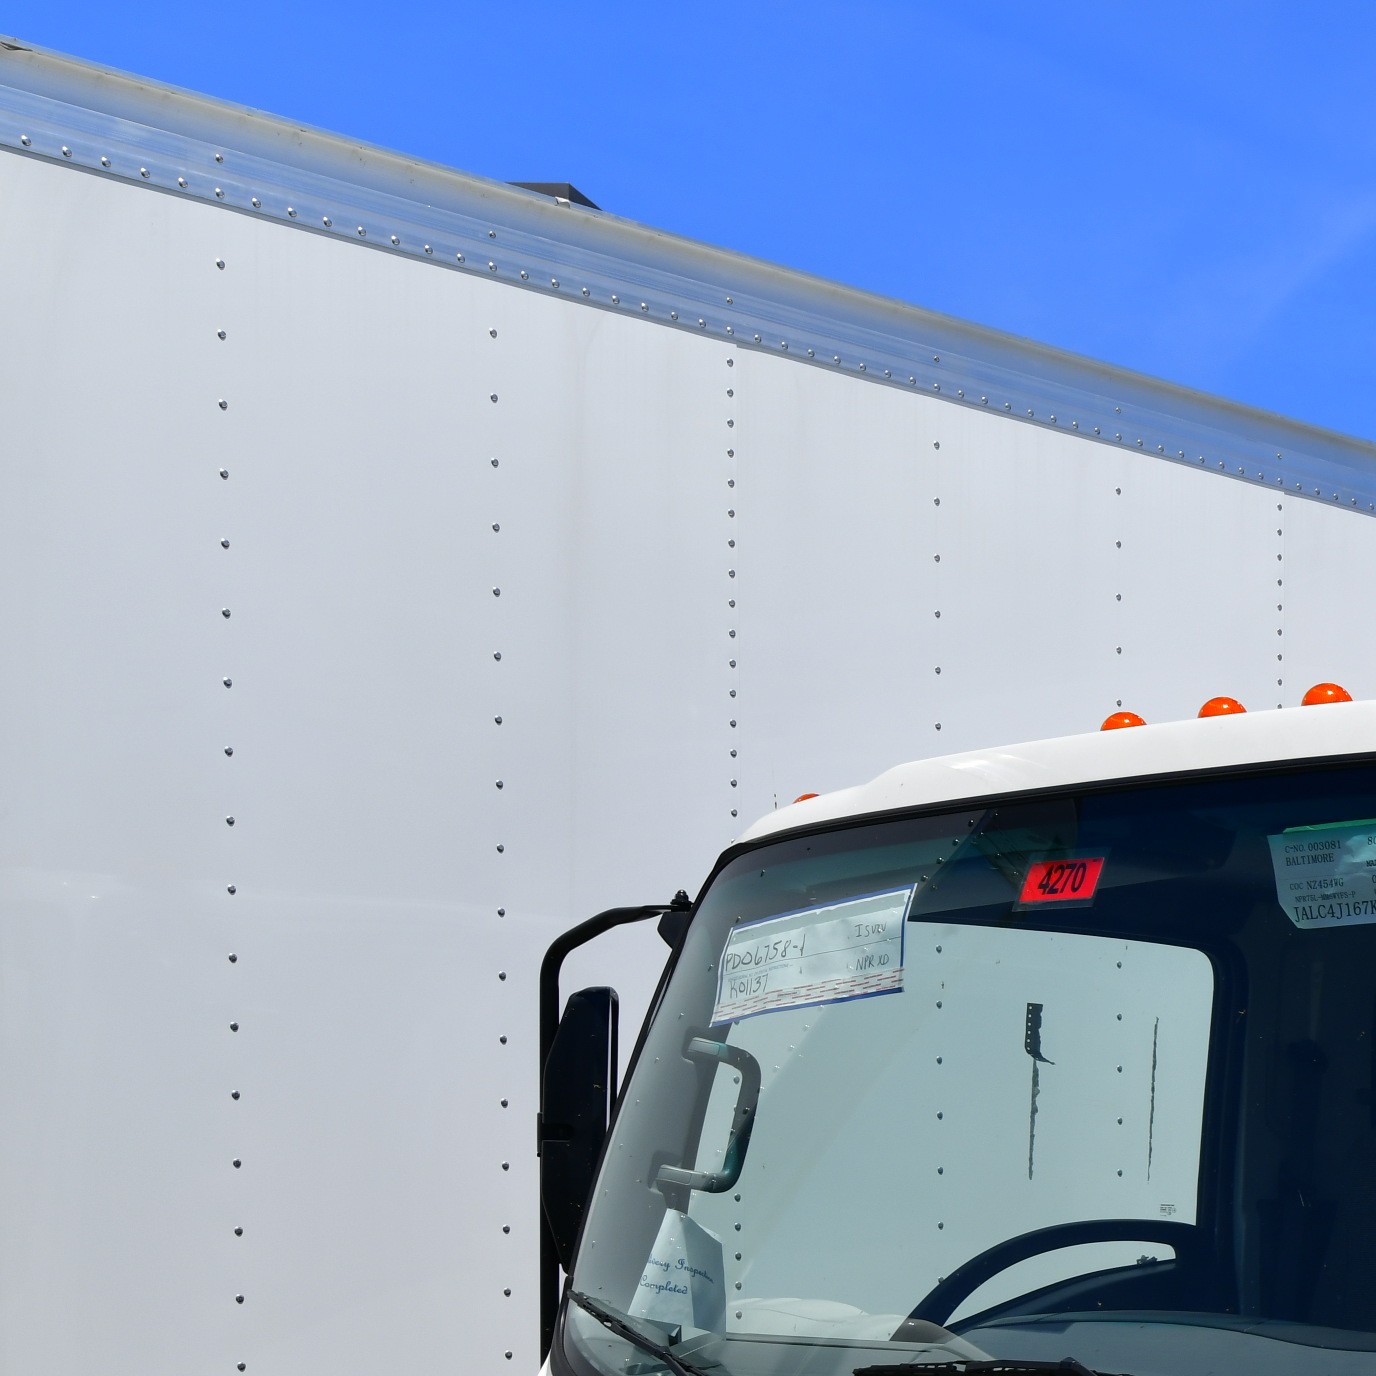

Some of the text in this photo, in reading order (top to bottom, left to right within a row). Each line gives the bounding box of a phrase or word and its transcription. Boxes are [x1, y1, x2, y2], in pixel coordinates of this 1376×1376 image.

[1307, 840, 1342, 851] 003081
[1285, 854, 1335, 867] BALTIMORE
[1037, 862, 1087, 895] 4270
[855, 953, 890, 971] NPR XD
[729, 974, 768, 999] K01137
[640, 1274, 688, 1295] Completed
